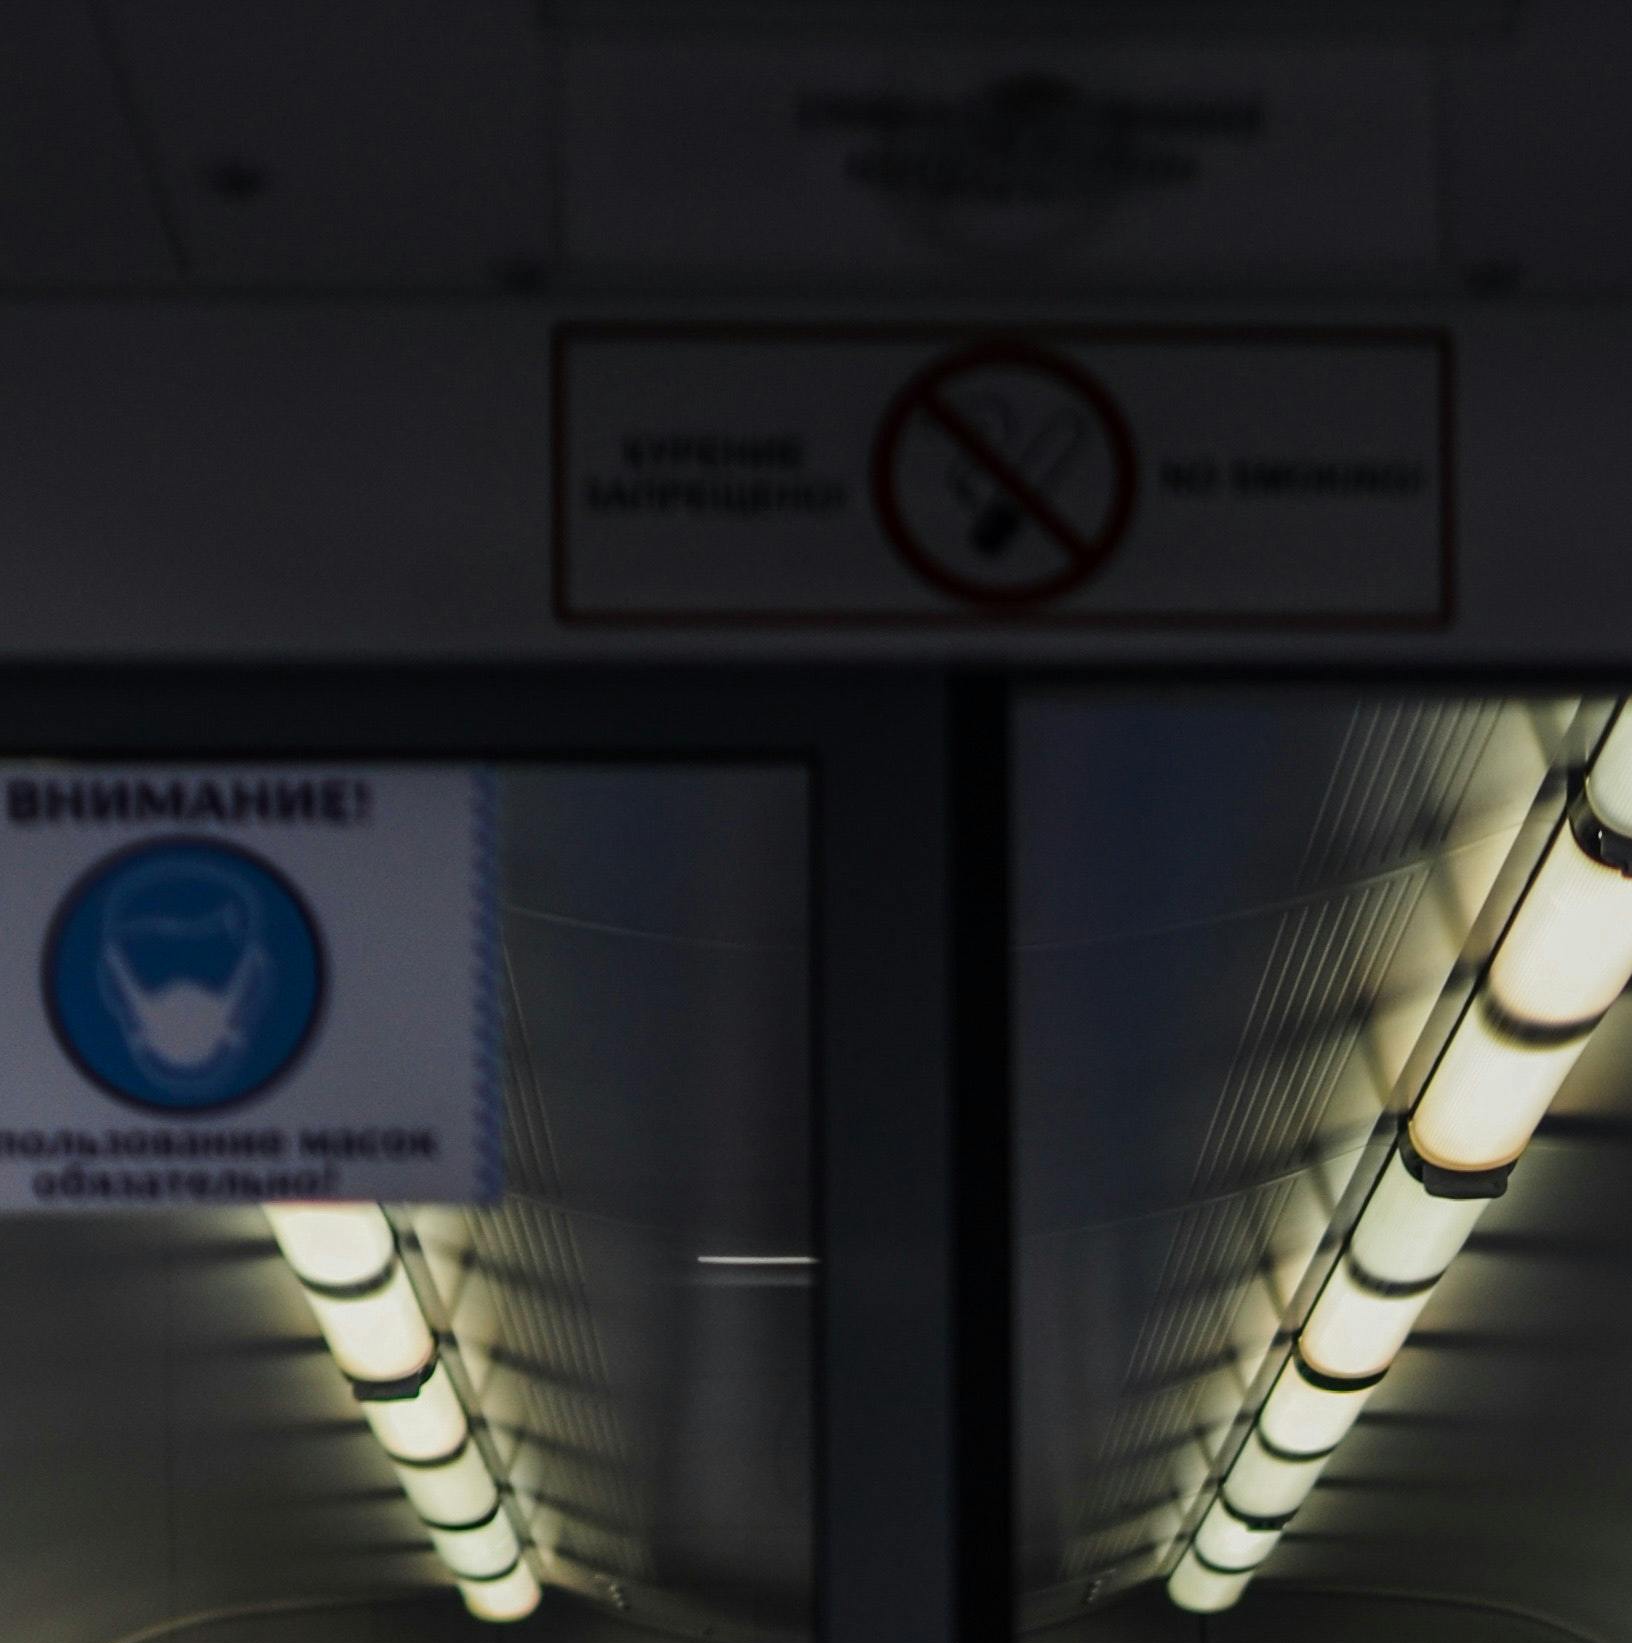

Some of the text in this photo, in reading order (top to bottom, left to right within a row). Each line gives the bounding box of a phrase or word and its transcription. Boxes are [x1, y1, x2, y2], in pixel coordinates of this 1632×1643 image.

[1160, 458, 1219, 495] NO
[5, 777, 372, 825] ВНИМАНИЕ!
[299, 1127, 437, 1159] масок
[31, 1162, 340, 1198] обязательно!
